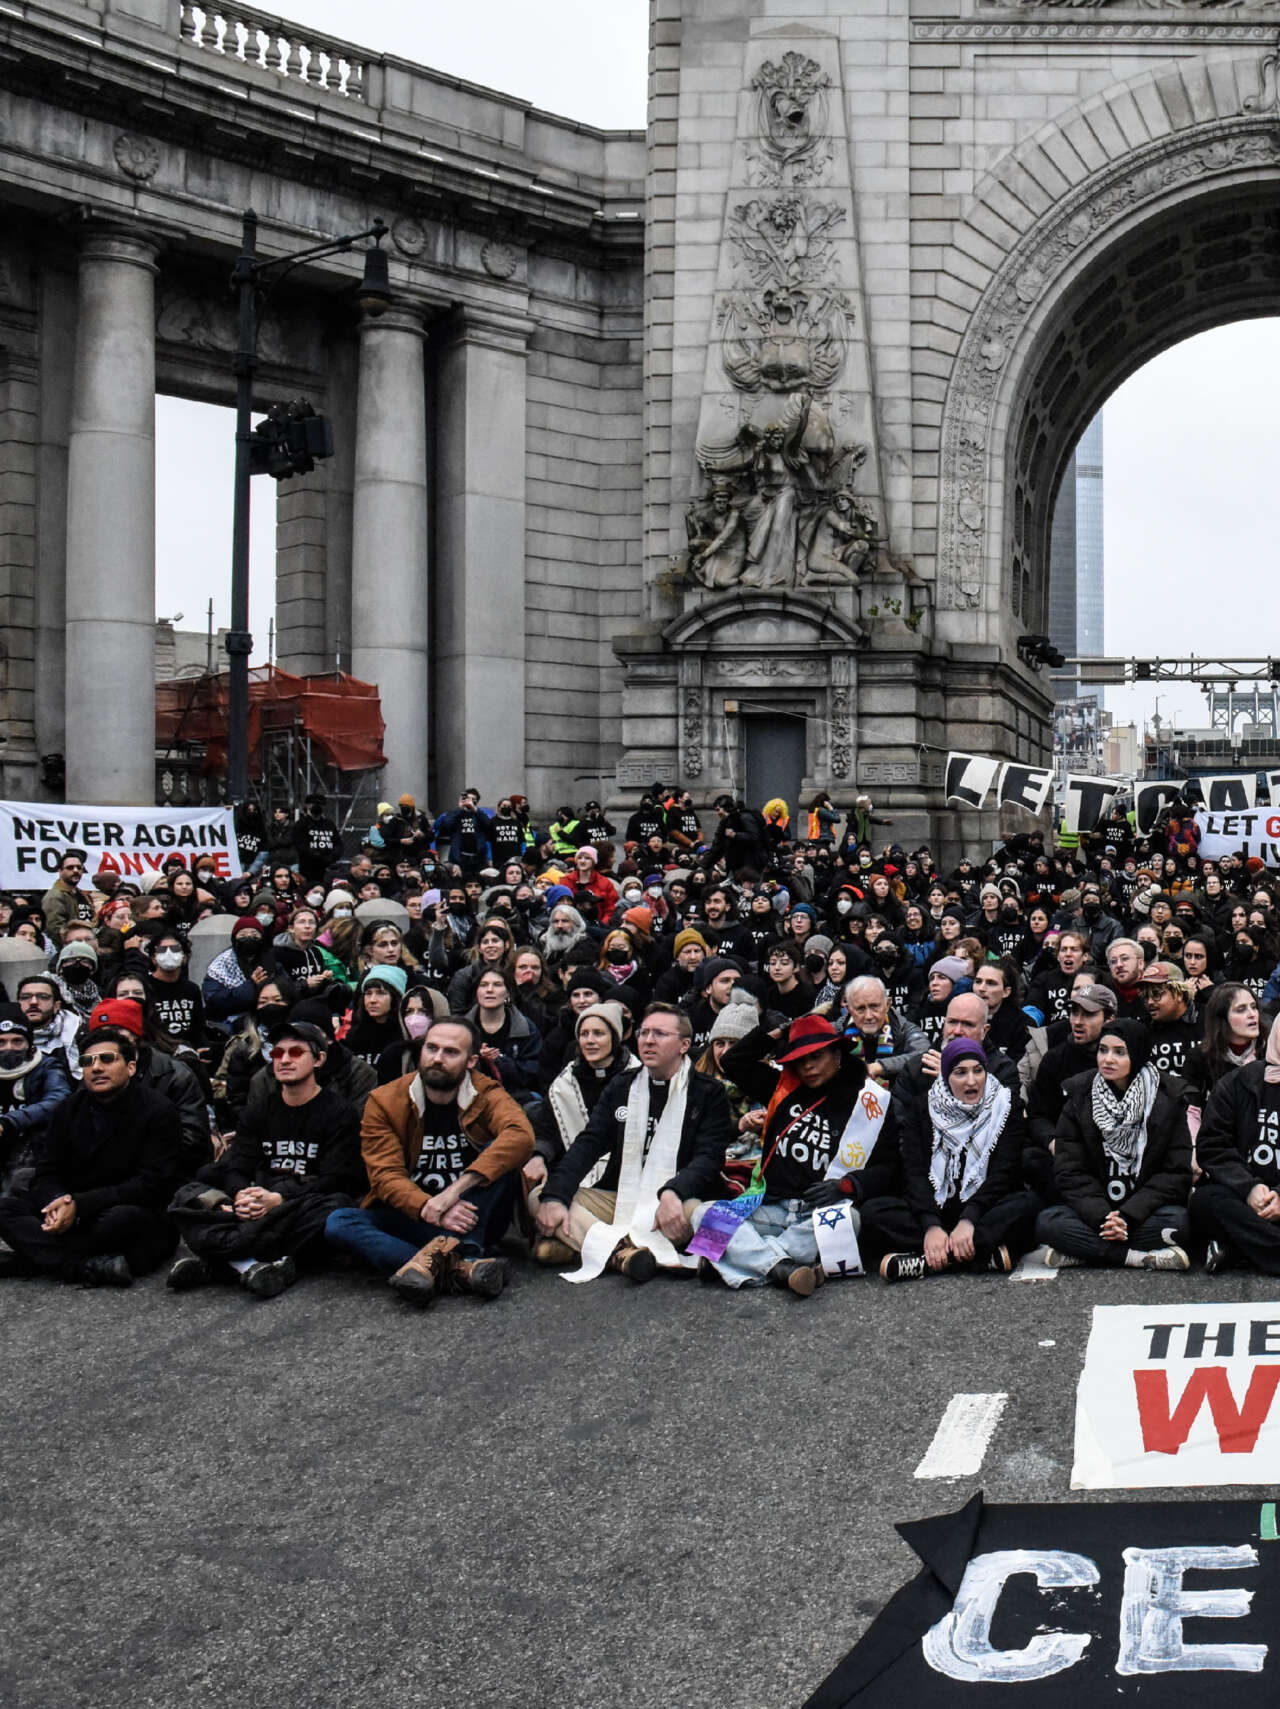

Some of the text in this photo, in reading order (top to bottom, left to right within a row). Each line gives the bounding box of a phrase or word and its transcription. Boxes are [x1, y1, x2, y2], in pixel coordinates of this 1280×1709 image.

[946, 757, 1118, 832] LET
[12, 816, 228, 847] NEVER AGAIN
[1206, 815, 1259, 836] LET
[310, 841, 333, 849] NOW
[98, 851, 232, 878] ANYE
[721, 940, 734, 949] IN
[895, 986, 908, 995] IN
[1048, 987, 1067, 999] NO
[160, 1010, 191, 1021] FIRE
[920, 1015, 945, 1030] EW
[1151, 1041, 1182, 1055] NOT
[1156, 1055, 1185, 1070] OU
[422, 1133, 468, 1151] EASE
[788, 1122, 831, 1149] FIRE
[262, 1140, 319, 1158] CEASE
[776, 1135, 830, 1172] NOW
[417, 1152, 464, 1170] FIRE
